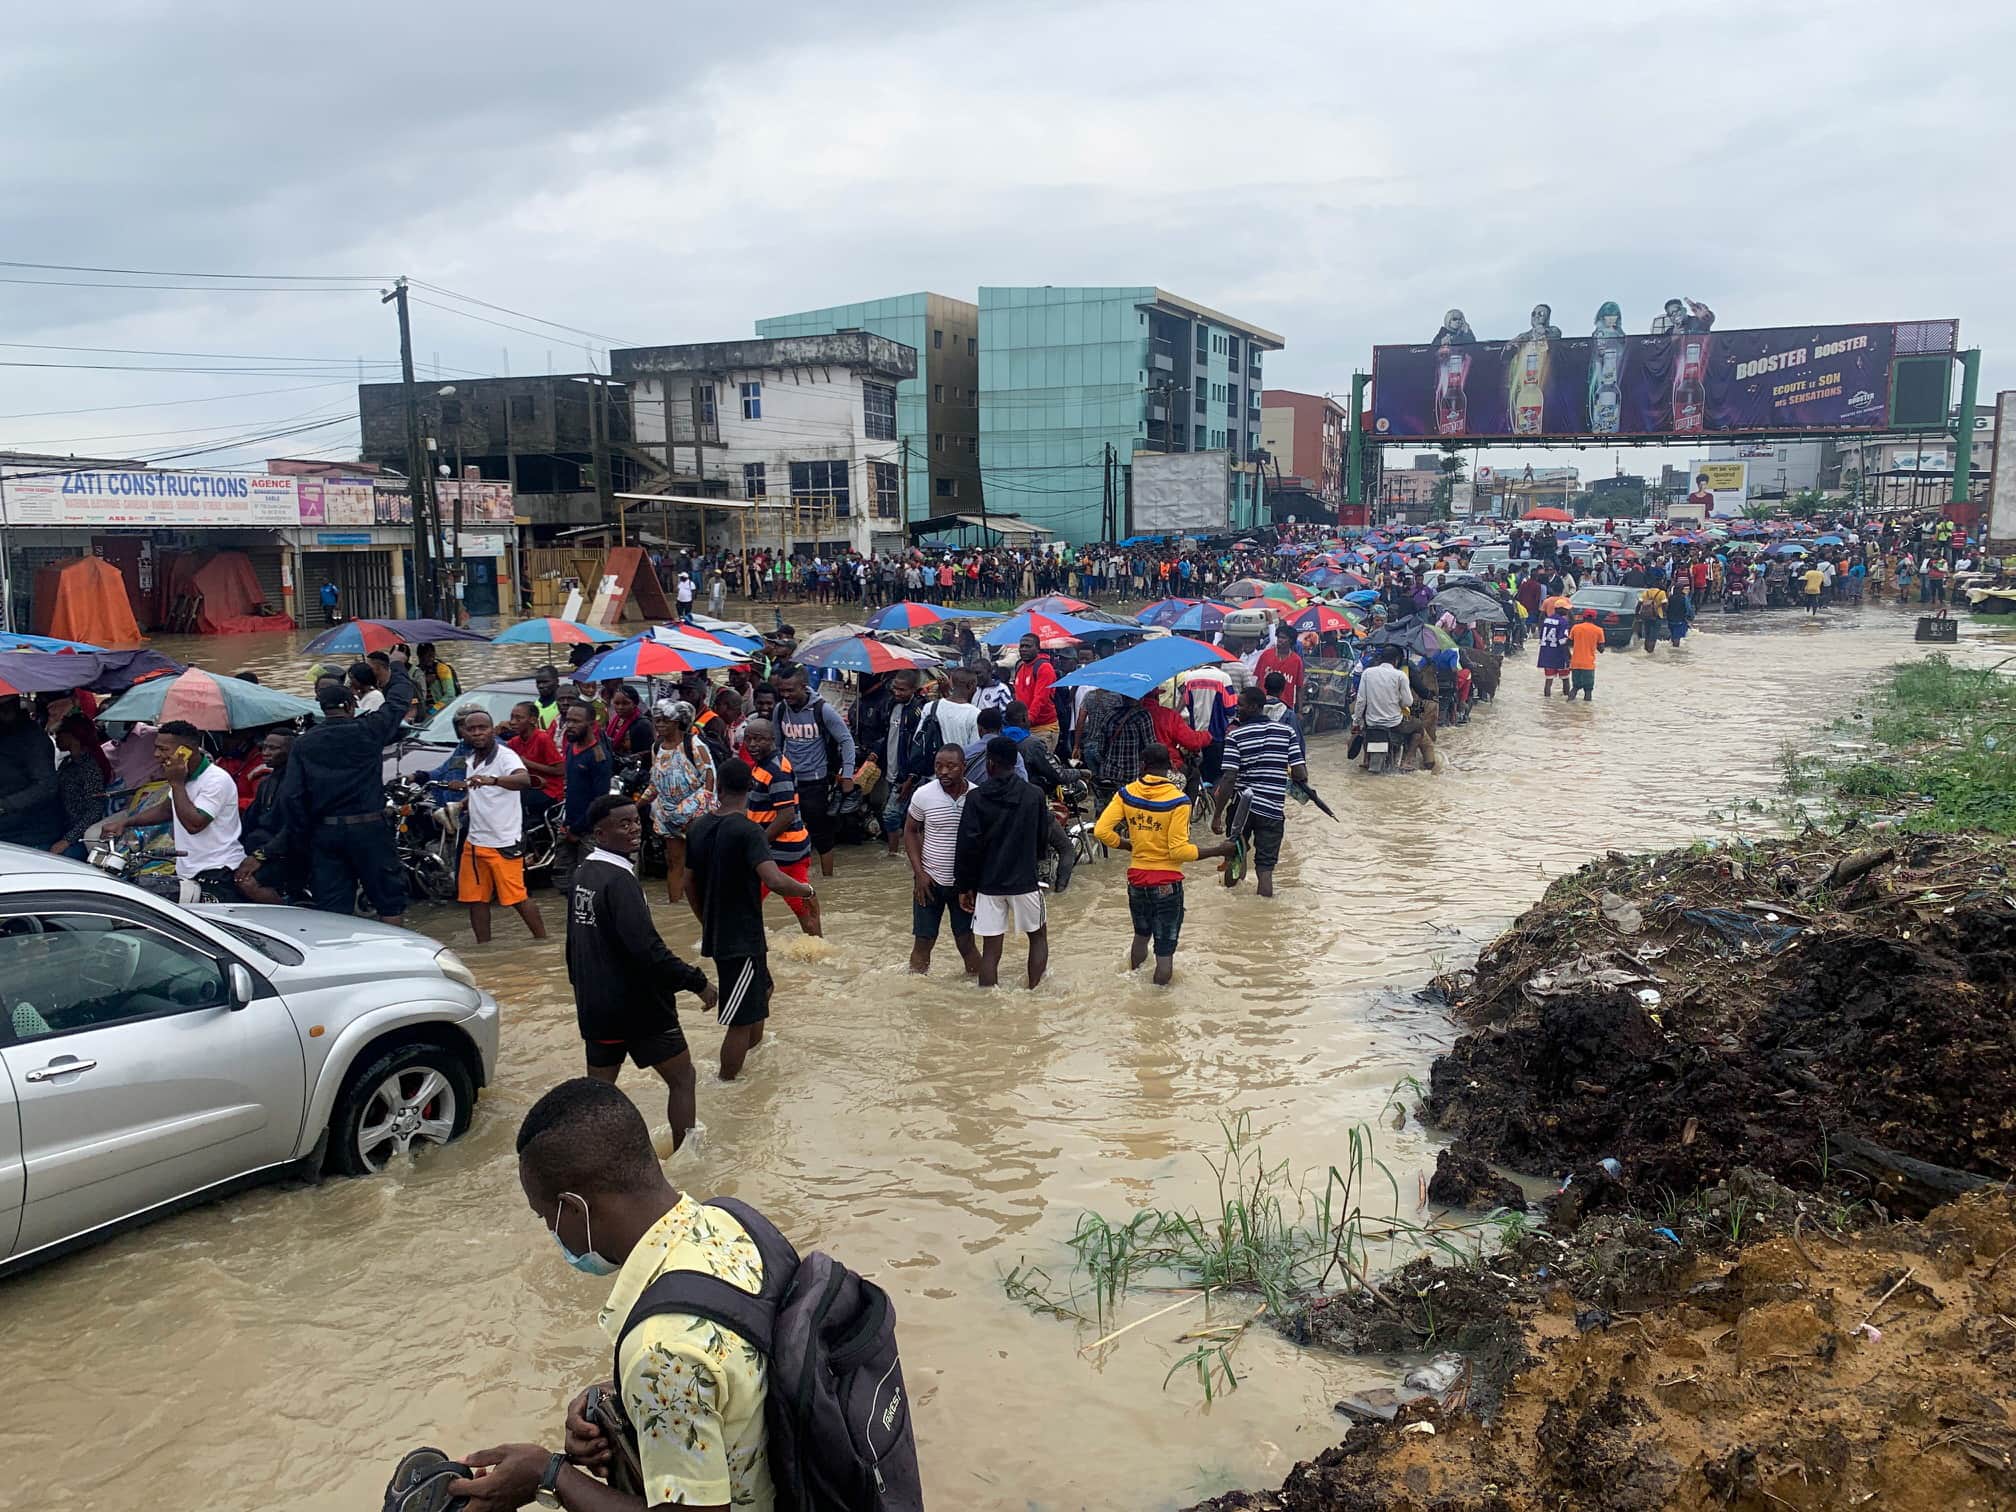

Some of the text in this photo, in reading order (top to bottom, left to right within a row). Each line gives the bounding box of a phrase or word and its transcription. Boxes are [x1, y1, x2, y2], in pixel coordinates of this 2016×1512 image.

[1736, 335, 1868, 380] BOOSTER BOOSTER
[1773, 380, 1807, 396] ECOUTE
[1818, 372, 1841, 387] SON
[1788, 385, 1842, 405] SENSATIONS
[62, 472, 248, 498] ZATI CONSTRUCTIONS
[251, 479, 291, 488] AGENCE
[1540, 626, 1557, 647] 14
